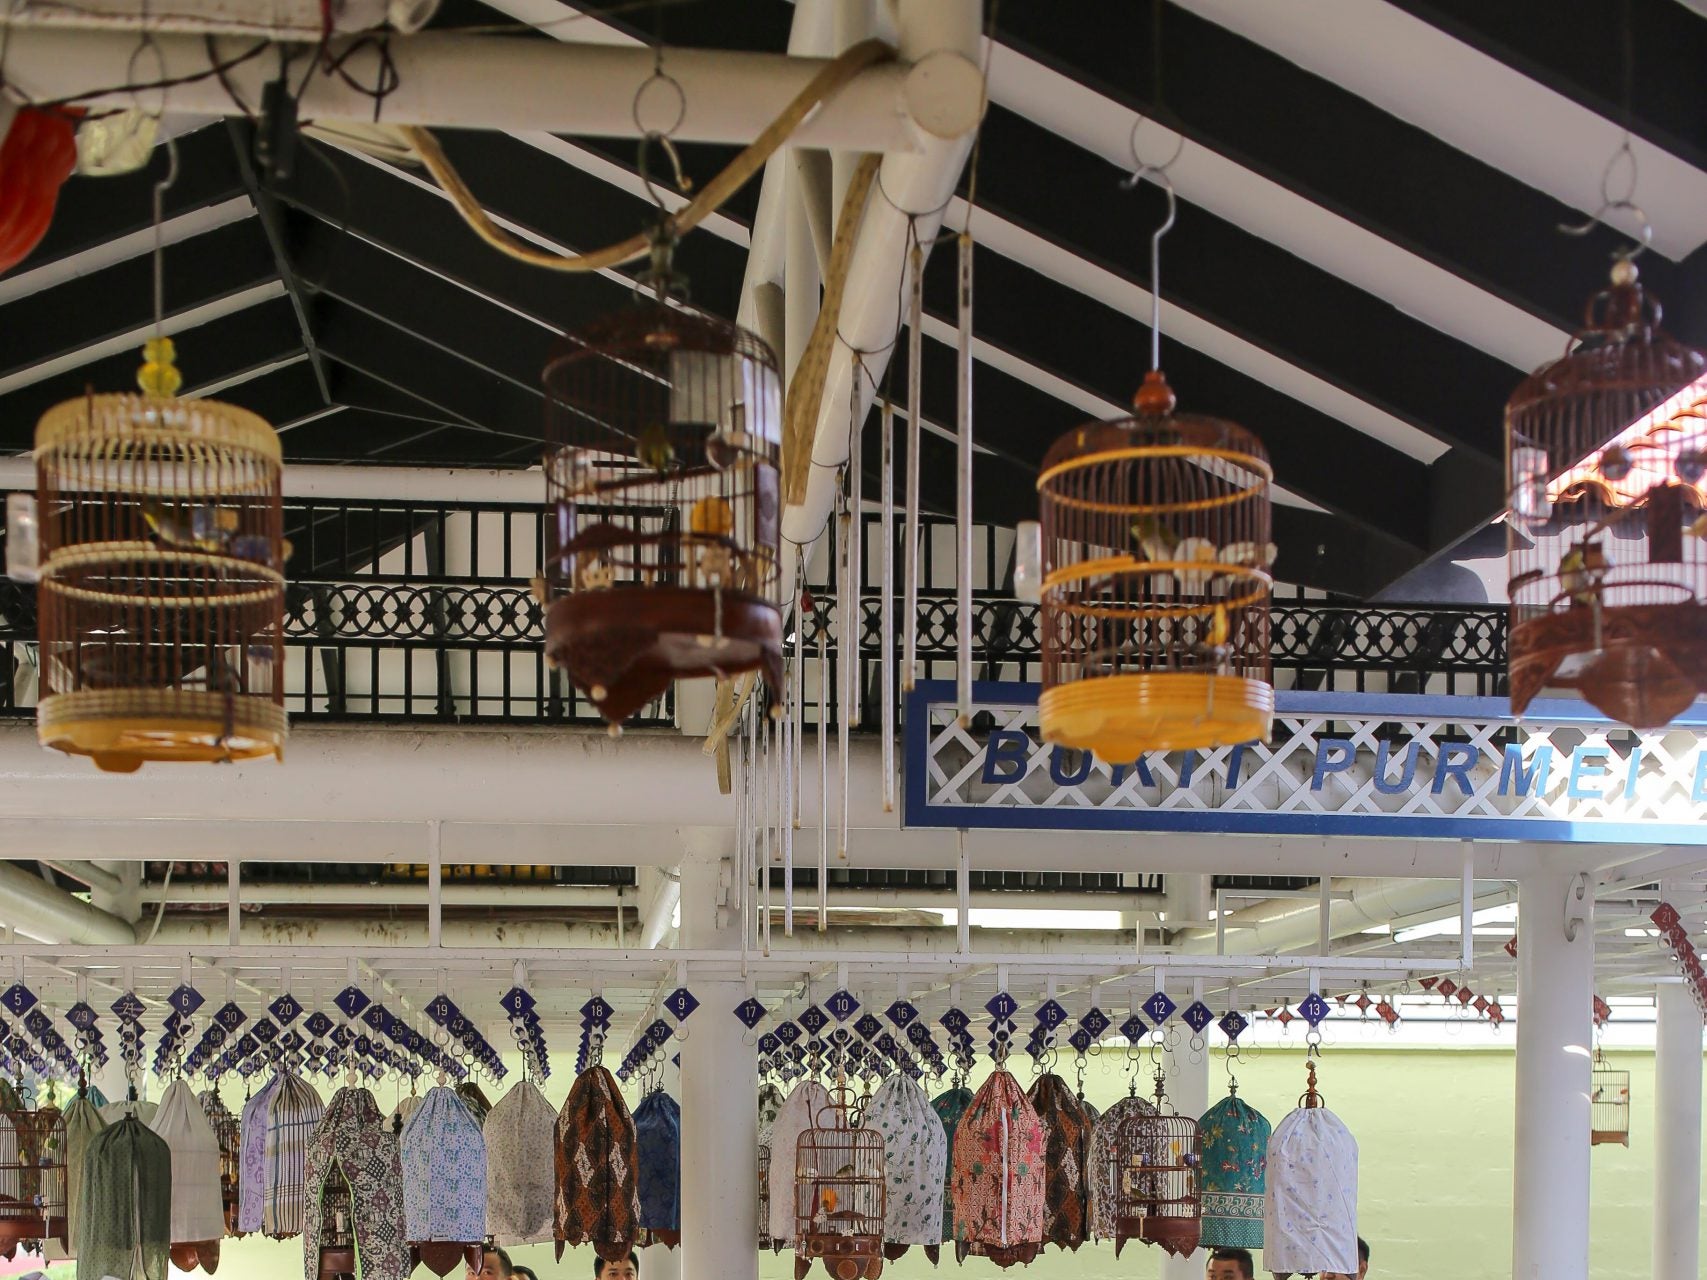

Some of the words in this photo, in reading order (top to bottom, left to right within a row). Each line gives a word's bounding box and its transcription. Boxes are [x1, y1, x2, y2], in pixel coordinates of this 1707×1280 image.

[1309, 738, 1643, 799] PURMEI
[14, 993, 21, 1005] 5
[182, 994, 189, 1006] 6
[348, 995, 355, 1007] 7
[514, 997, 521, 1009] 8
[678, 998, 685, 1010] 9
[279, 1003, 292, 1015] 20
[436, 1005, 447, 1016] 19
[837, 999, 849, 1011] 10
[998, 1001, 1008, 1013] 11
[1153, 1001, 1166, 1014] 12
[1308, 1003, 1320, 1016] 13
[75, 1011, 88, 1022] 29
[224, 1011, 237, 1022] 30
[592, 1006, 602, 1016] 18
[745, 1006, 756, 1018] 17
[896, 1007, 908, 1019] 16
[1046, 1009, 1057, 1020] 15
[1192, 1011, 1204, 1022] 14
[372, 1012, 383, 1023] 31
[807, 1014, 820, 1026] 33
[948, 1015, 961, 1026] 34
[1089, 1018, 1101, 1028] 35
[31, 1018, 42, 1029] 45
[312, 1020, 325, 1030] 43
[453, 1020, 464, 1030] 42
[862, 1022, 874, 1032] 39
[1227, 1019, 1240, 1030] 36
[260, 1027, 270, 1036] 54
[391, 1025, 403, 1036] 55
[654, 1026, 665, 1037] 57
[782, 1027, 794, 1037] 58
[1129, 1024, 1140, 1035] 37
[46, 1036, 56, 1045] 76
[210, 1031, 222, 1040] 68
[1077, 1036, 1086, 1046] 61
[242, 1040, 253, 1050] 92
[358, 1041, 367, 1050] 91
[408, 1037, 419, 1046] 79
[763, 1038, 775, 1048] 82
[880, 1039, 891, 1049] 83
